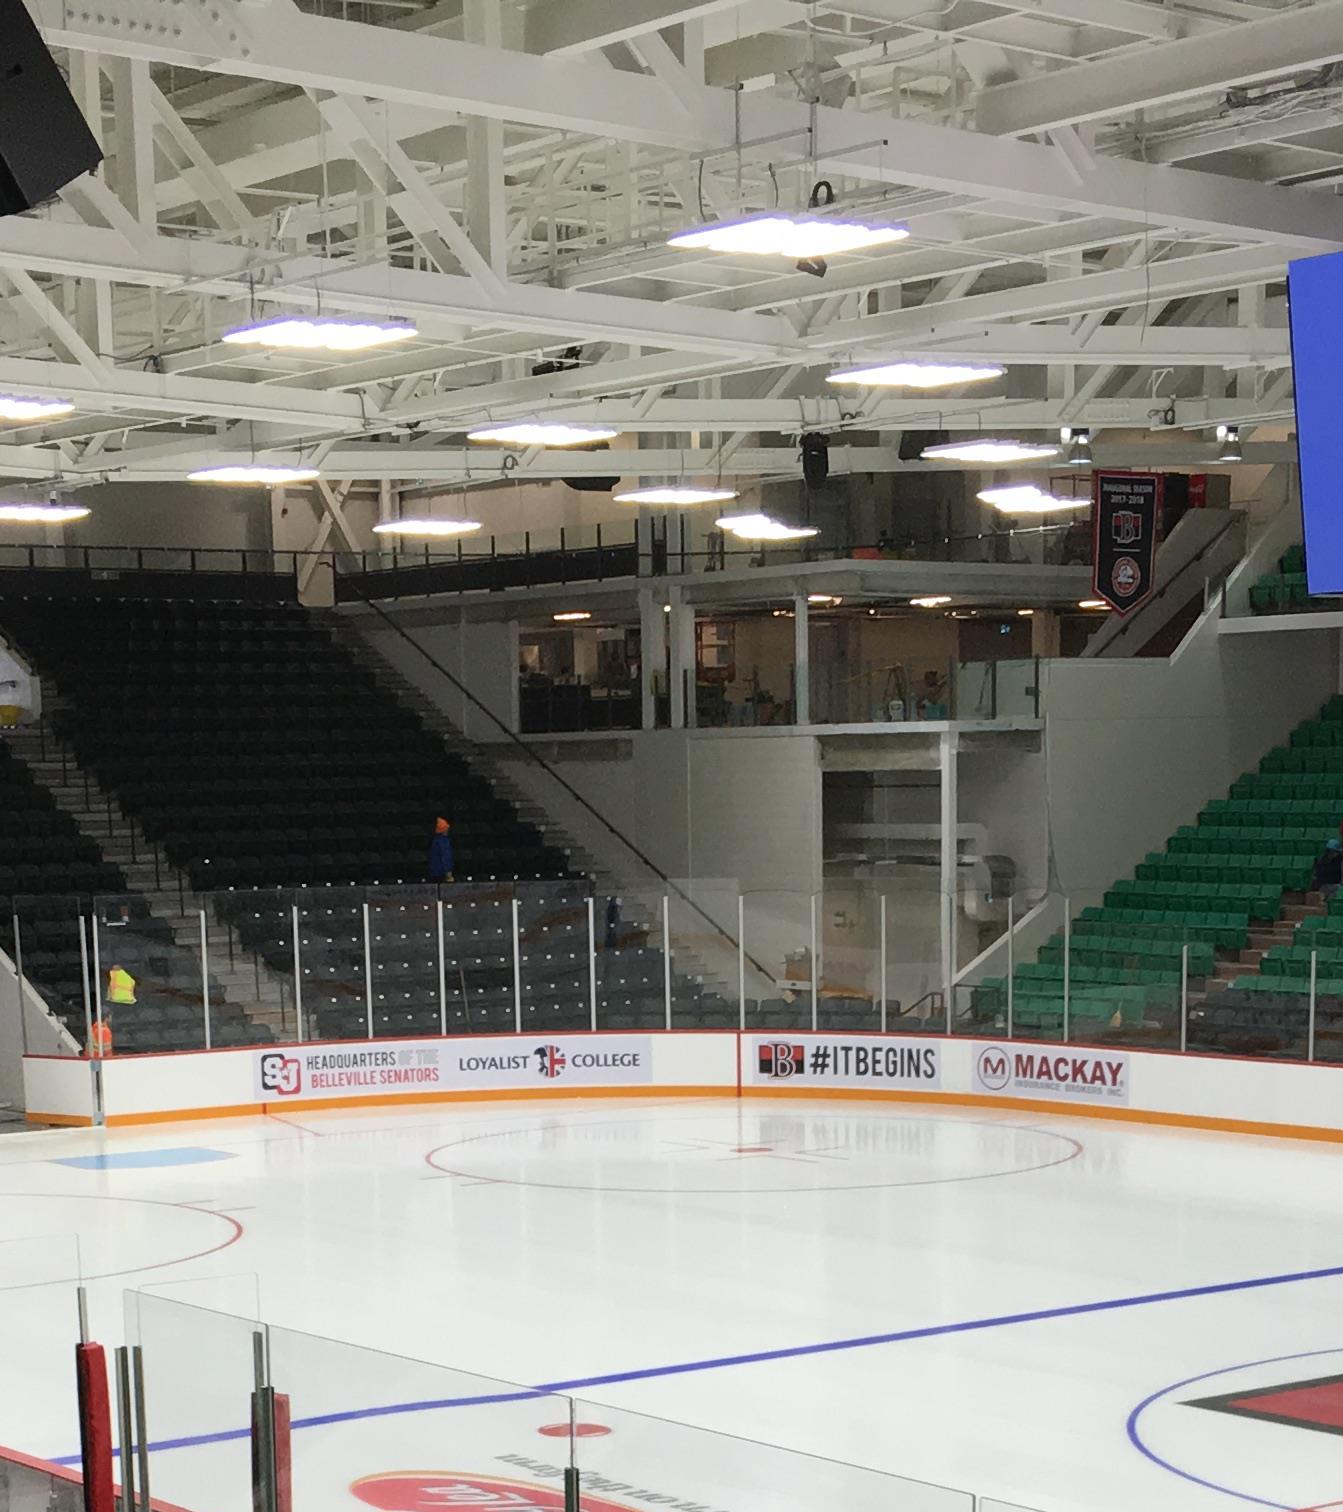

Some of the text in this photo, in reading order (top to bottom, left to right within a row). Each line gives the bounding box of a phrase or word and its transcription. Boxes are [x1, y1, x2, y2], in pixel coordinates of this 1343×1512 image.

[307, 1052, 396, 1070] HEADQUARTERS
[459, 1053, 641, 1071] LOYALIST COLLEGE
[809, 1045, 936, 1079] #ITBEGINS
[1014, 1054, 1123, 1086] MACKAY
[311, 1067, 439, 1089] BELLEVILLE SENATORS
[624, 1489, 679, 1505] on
